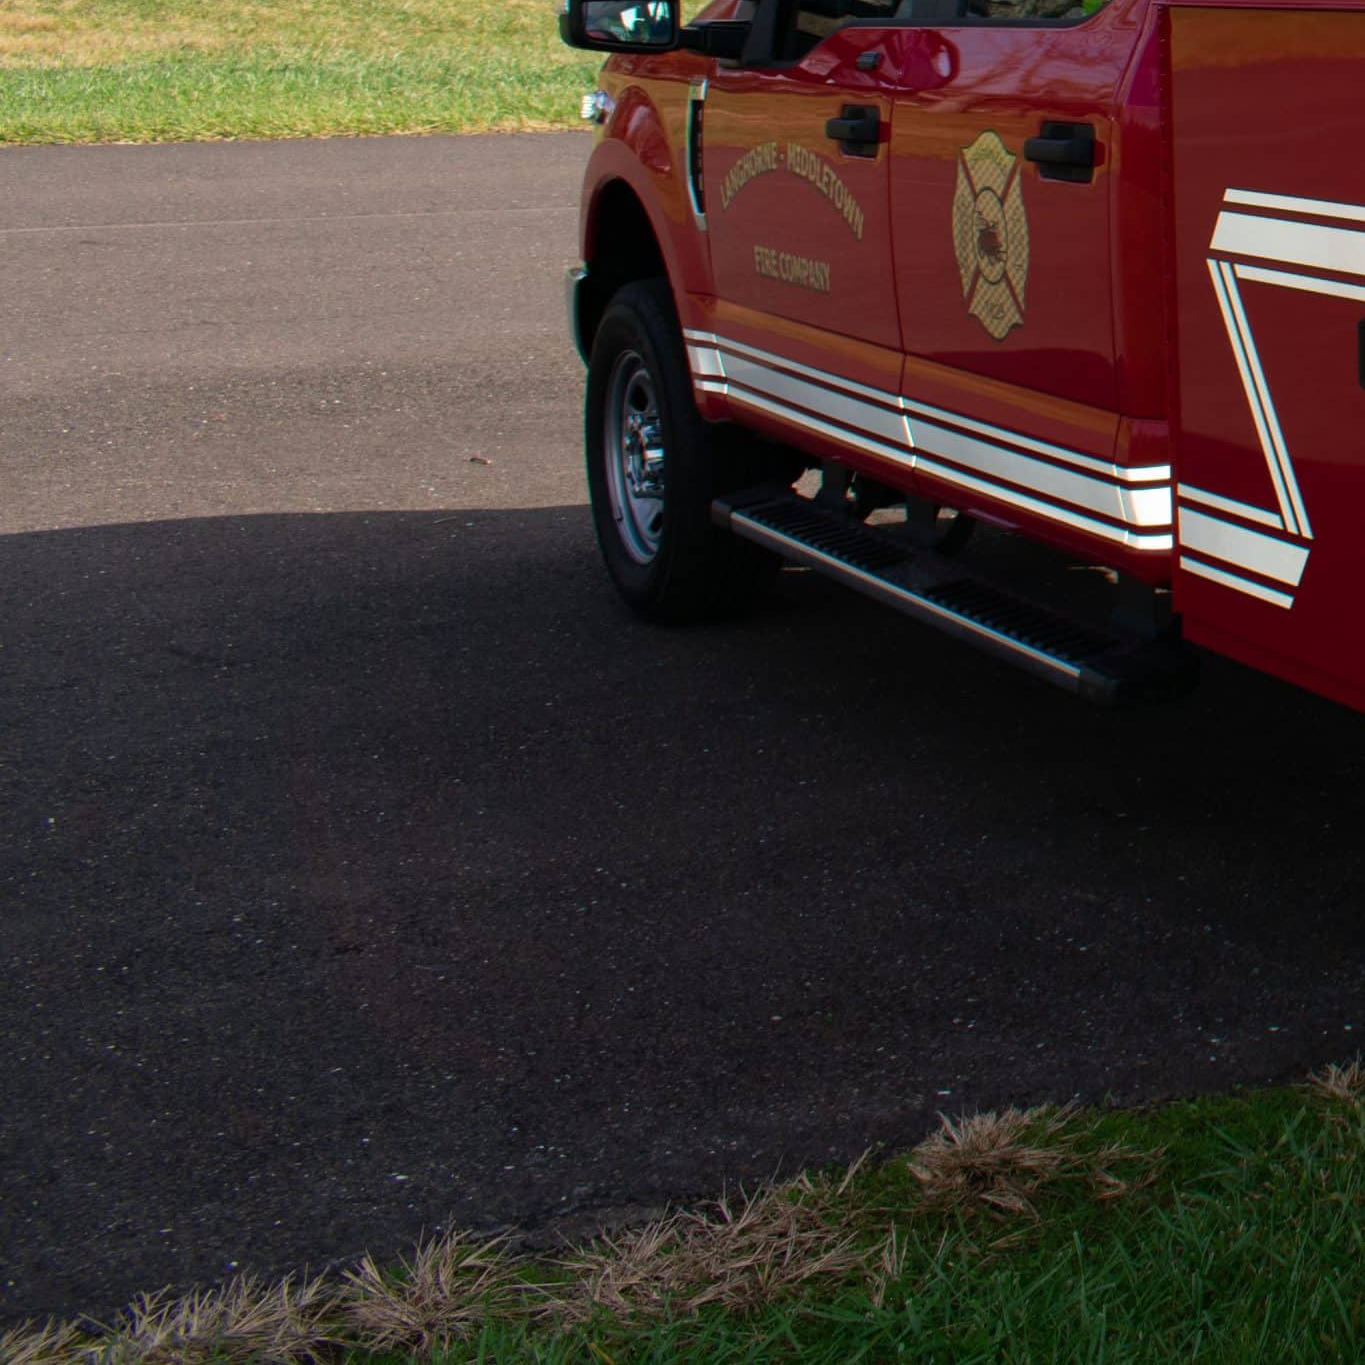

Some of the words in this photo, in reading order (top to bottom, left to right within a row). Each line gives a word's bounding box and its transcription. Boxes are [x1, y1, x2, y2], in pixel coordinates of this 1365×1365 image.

[720, 141, 778, 210] LANGHORNE
[786, 142, 865, 241] MIDDLETOWN
[753, 245, 778, 279] FIRE
[778, 251, 831, 292] COMPANY
